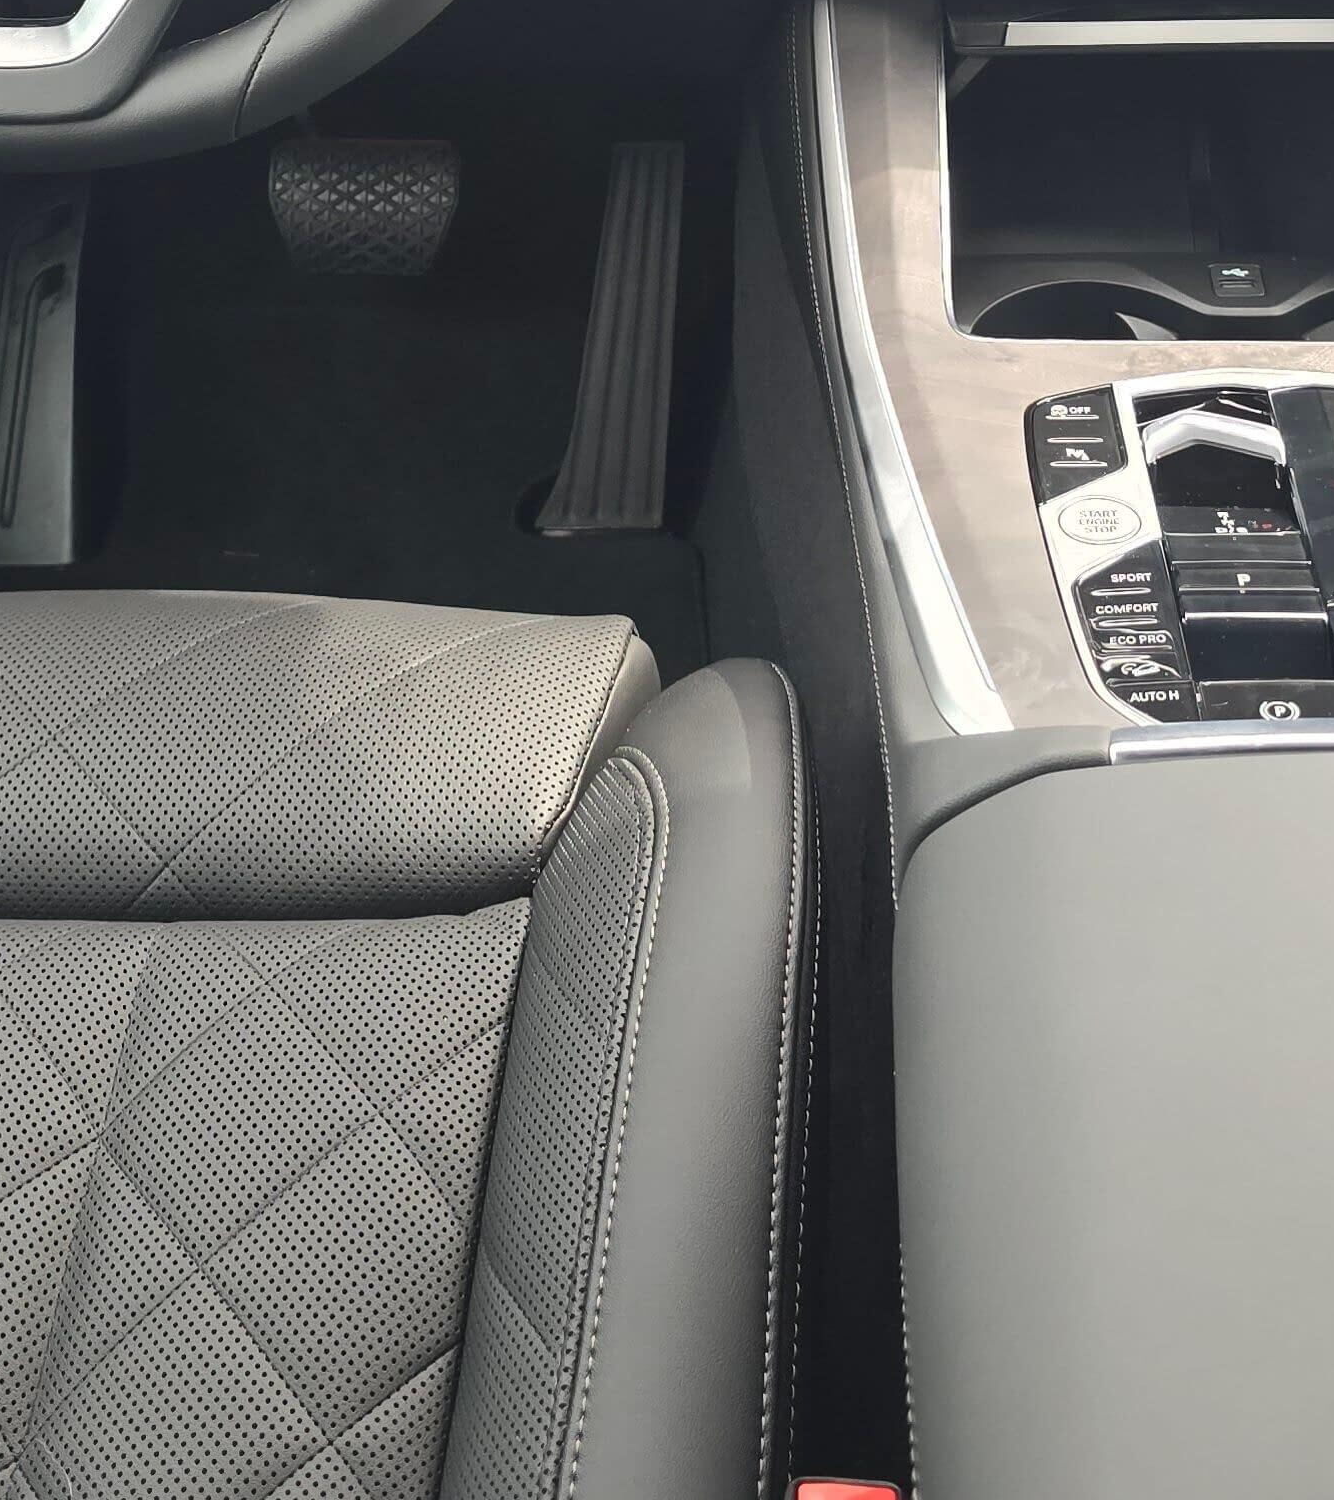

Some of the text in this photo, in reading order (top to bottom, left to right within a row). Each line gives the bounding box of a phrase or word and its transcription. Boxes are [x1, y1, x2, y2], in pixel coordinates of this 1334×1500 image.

[1068, 406, 1091, 415] OFF
[1079, 509, 1118, 518] START
[1084, 525, 1117, 533] STOP
[1110, 572, 1152, 583] SPORT
[1237, 573, 1251, 586] P
[1095, 602, 1159, 614] COMFORT
[1109, 634, 1167, 645] ECO PRO
[1129, 690, 1179, 703] AUTO H
